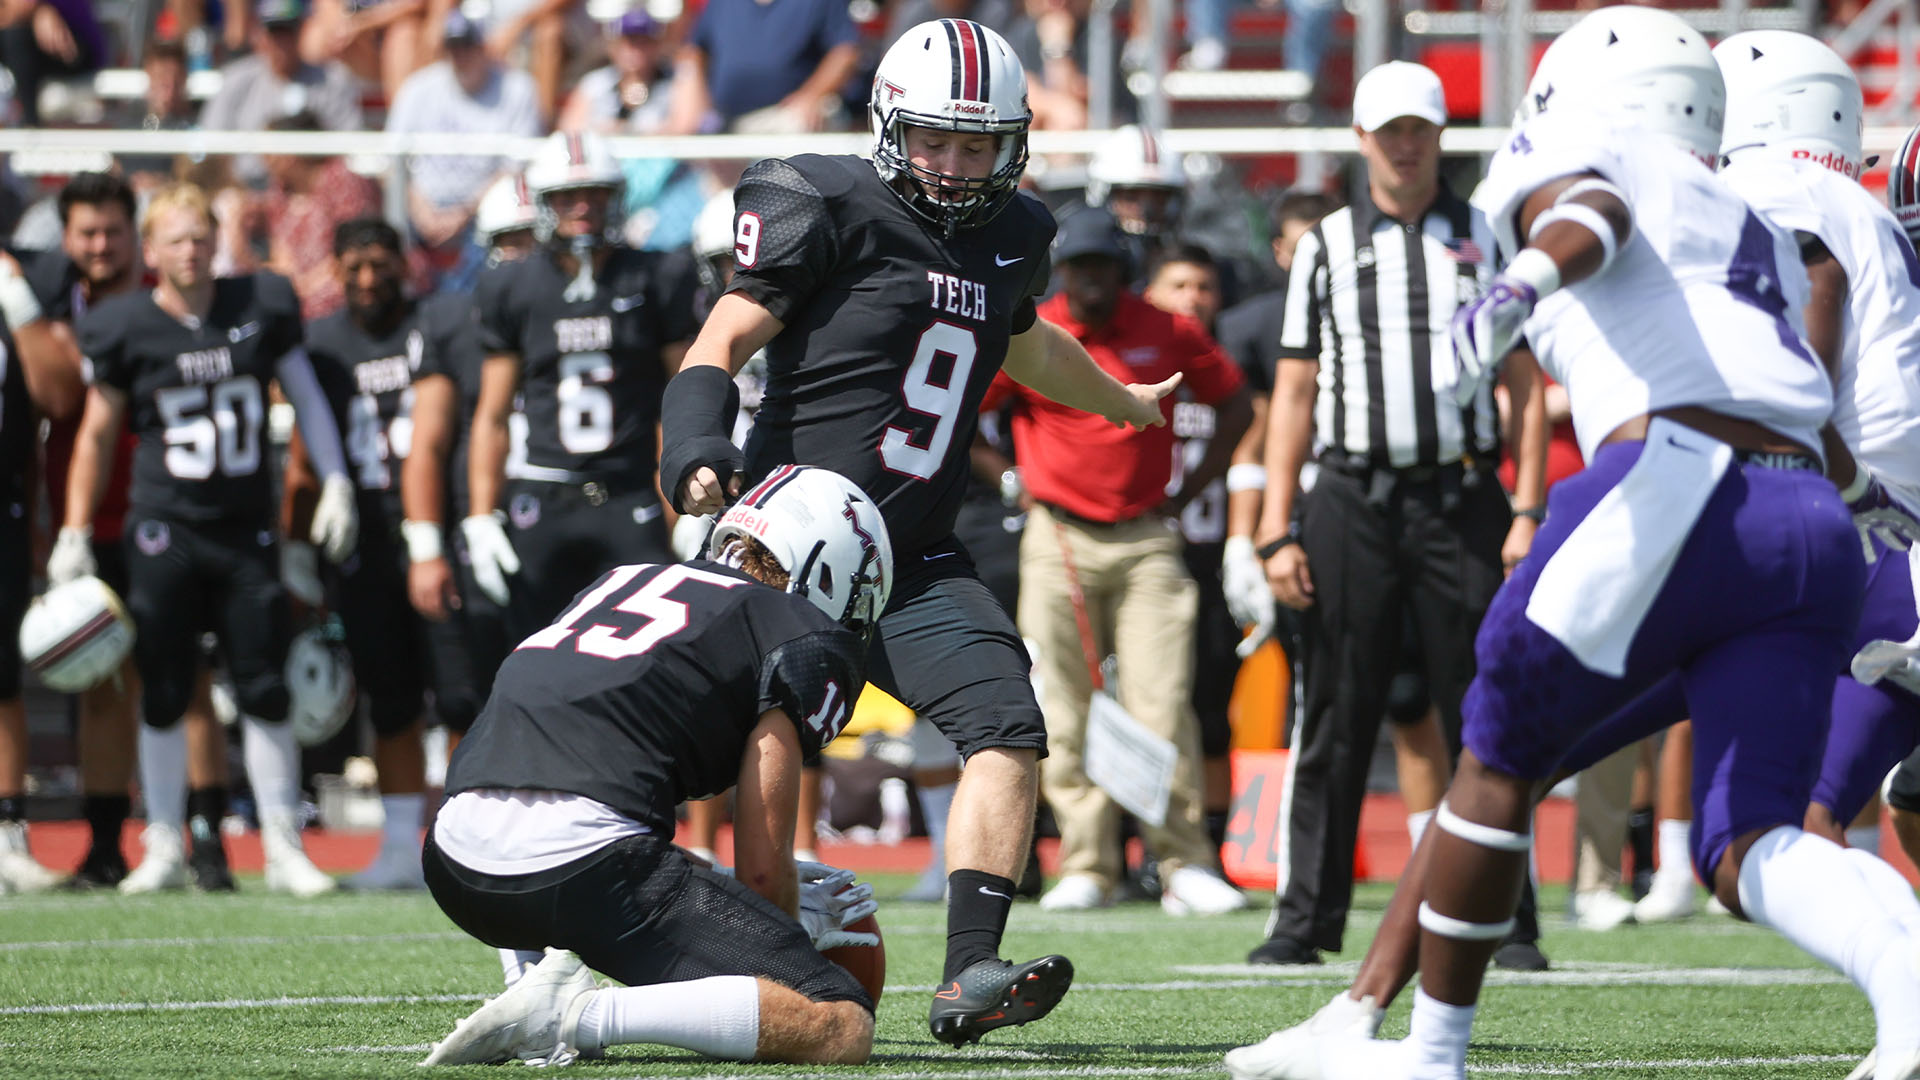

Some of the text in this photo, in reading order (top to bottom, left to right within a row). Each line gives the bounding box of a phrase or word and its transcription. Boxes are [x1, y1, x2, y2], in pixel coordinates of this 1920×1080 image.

[954, 103, 986, 115] Riddell
[734, 210, 764, 270] 9
[927, 270, 986, 321] TECH
[177, 346, 234, 385] TECH
[558, 352, 615, 454] 6
[876, 318, 980, 484] 9
[156, 376, 262, 478] 50
[513, 563, 753, 661] 15
